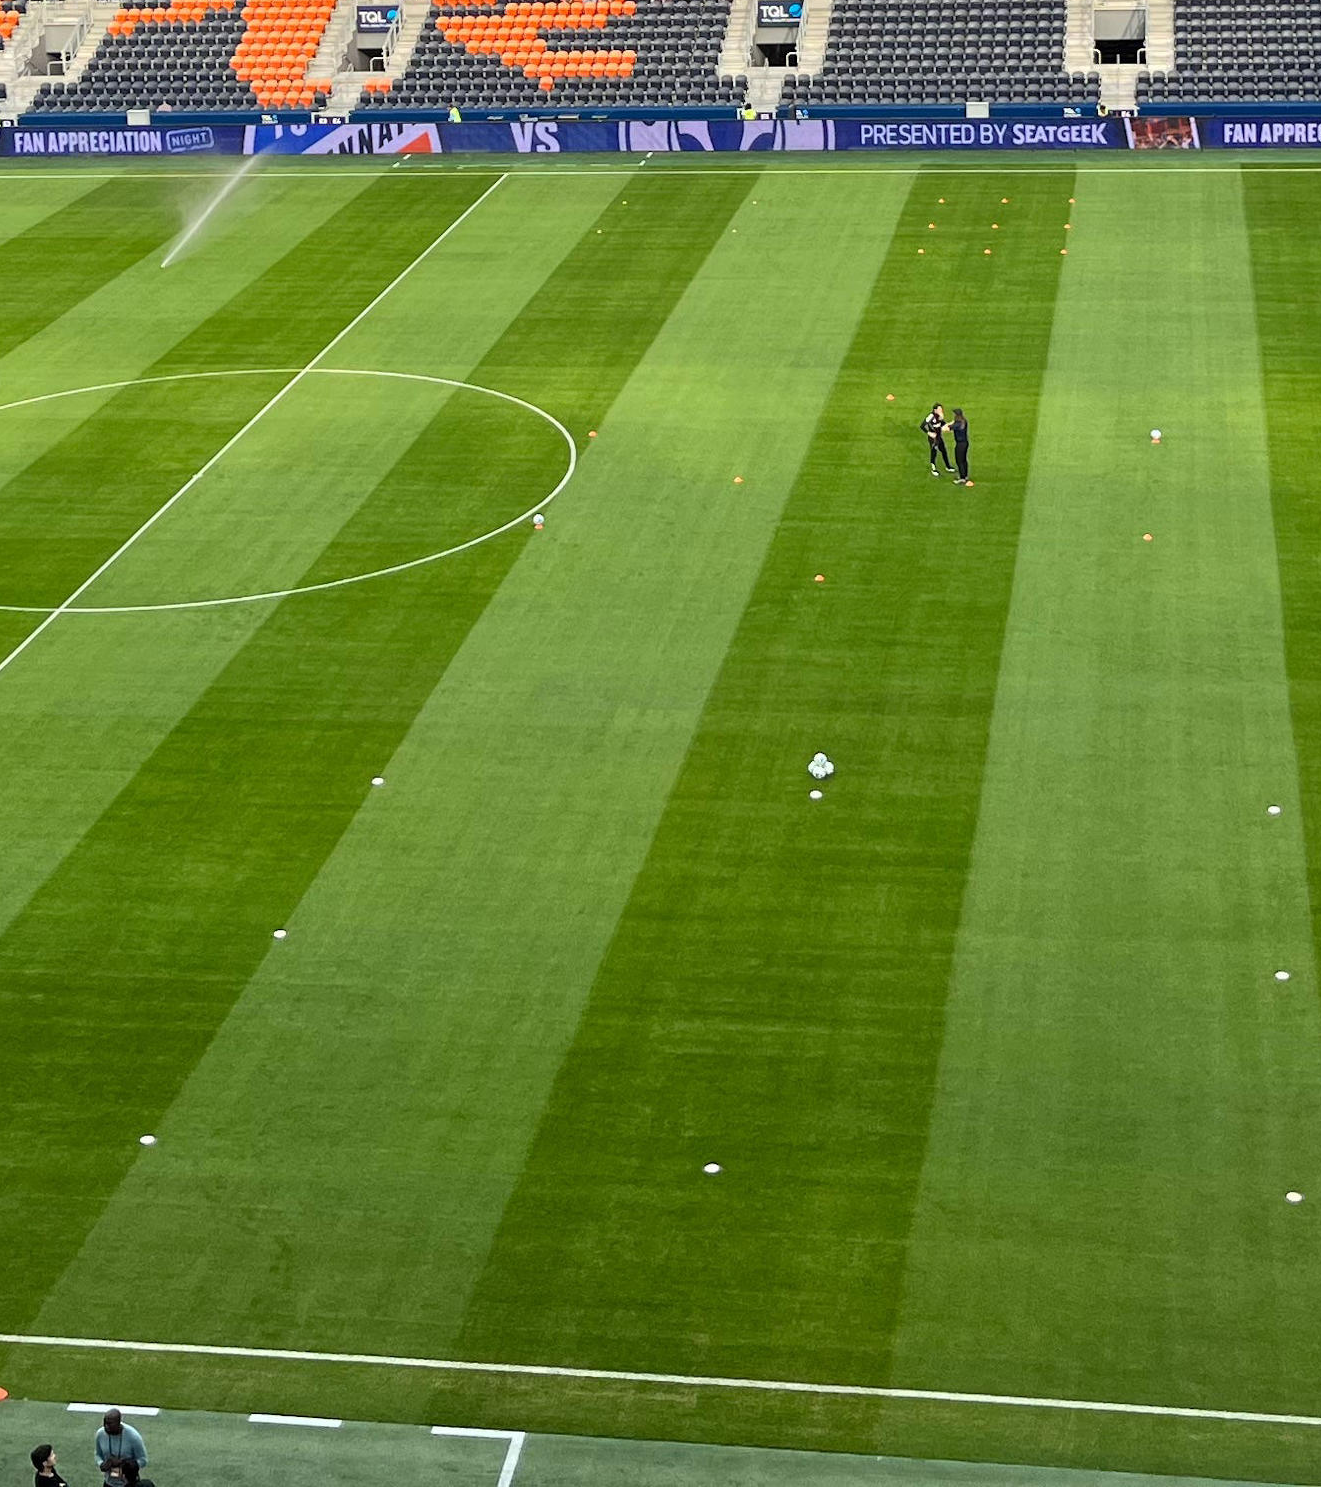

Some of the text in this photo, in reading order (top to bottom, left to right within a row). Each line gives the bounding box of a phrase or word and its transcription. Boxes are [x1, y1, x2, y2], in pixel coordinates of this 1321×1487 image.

[358, 10, 386, 23] TQL
[760, 5, 789, 18] TQL
[14, 129, 209, 153] FAN APPRECIATION NIGHT
[510, 122, 560, 153] VS
[860, 122, 1107, 145] PRESENTED BY SEATGEEK
[1224, 123, 1256, 143] FAN
